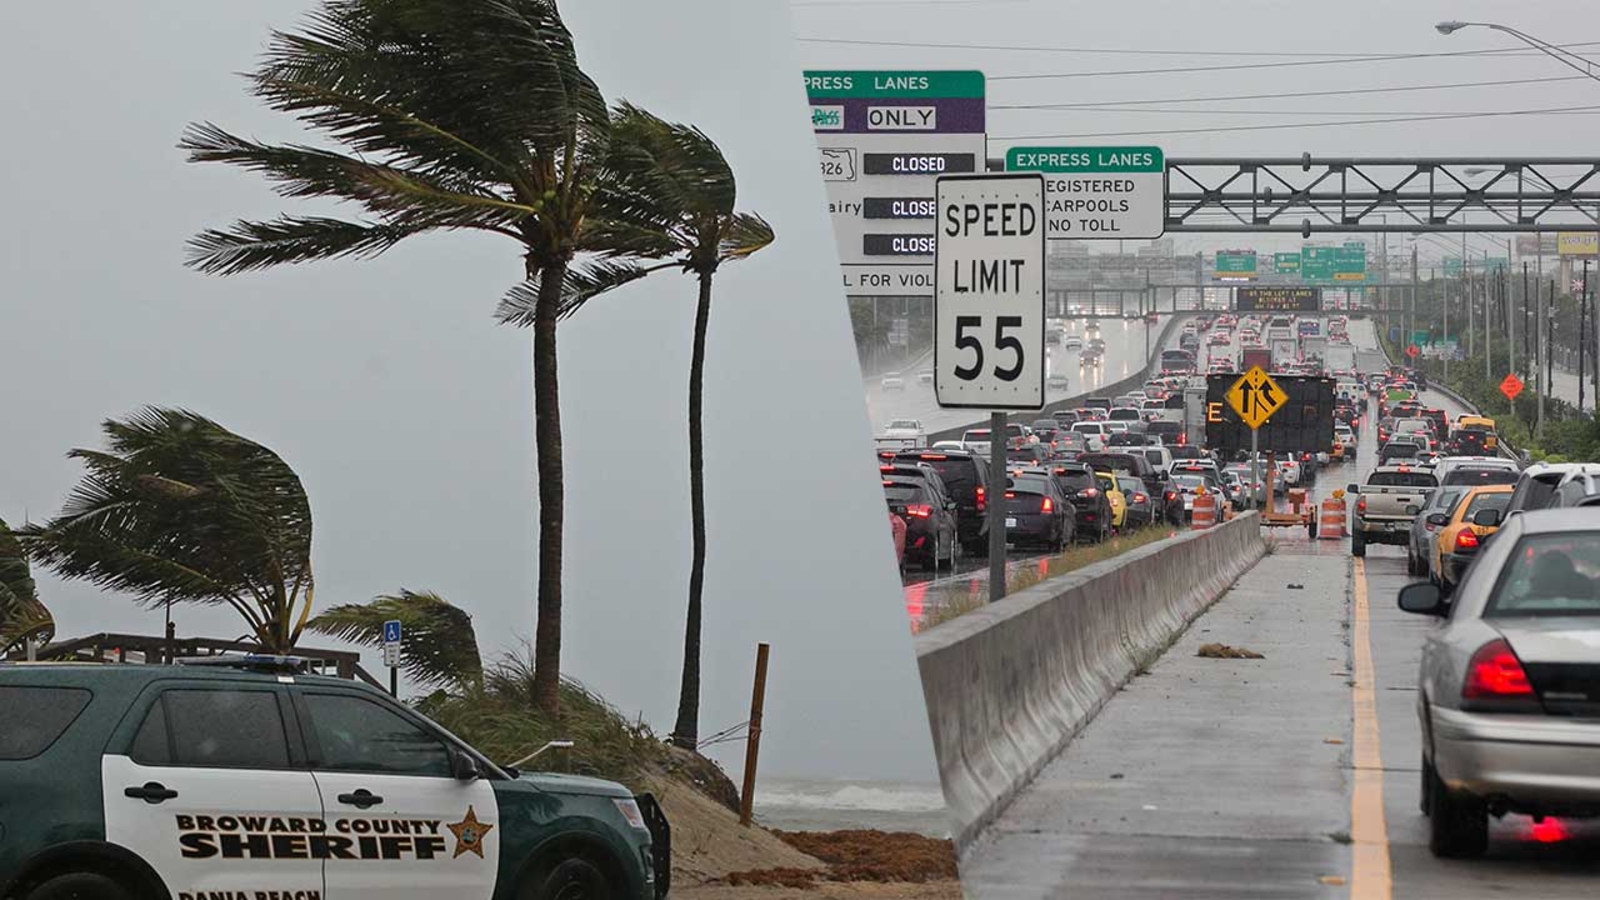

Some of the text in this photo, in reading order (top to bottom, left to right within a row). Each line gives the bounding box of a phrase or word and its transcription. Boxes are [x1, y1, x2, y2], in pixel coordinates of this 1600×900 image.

[874, 77, 929, 90] LANES
[869, 109, 933, 126] ONLY
[892, 157, 945, 171] CLOSED
[1016, 153, 1153, 167] EXPRESS LANES
[1046, 180, 1135, 193] EGISTERED
[829, 200, 862, 216] airy
[945, 203, 1036, 237] SPEED
[1049, 219, 1121, 232] NO TOLL
[860, 274, 891, 287] FOR
[898, 274, 934, 287] VIOL
[954, 259, 1025, 295] LIMIT
[954, 315, 1025, 382] 55
[1208, 402, 1223, 422] E
[175, 814, 442, 835] BROWARD COUNTY
[179, 833, 447, 860] SHERIFF
[178, 891, 248, 900] DANIA
